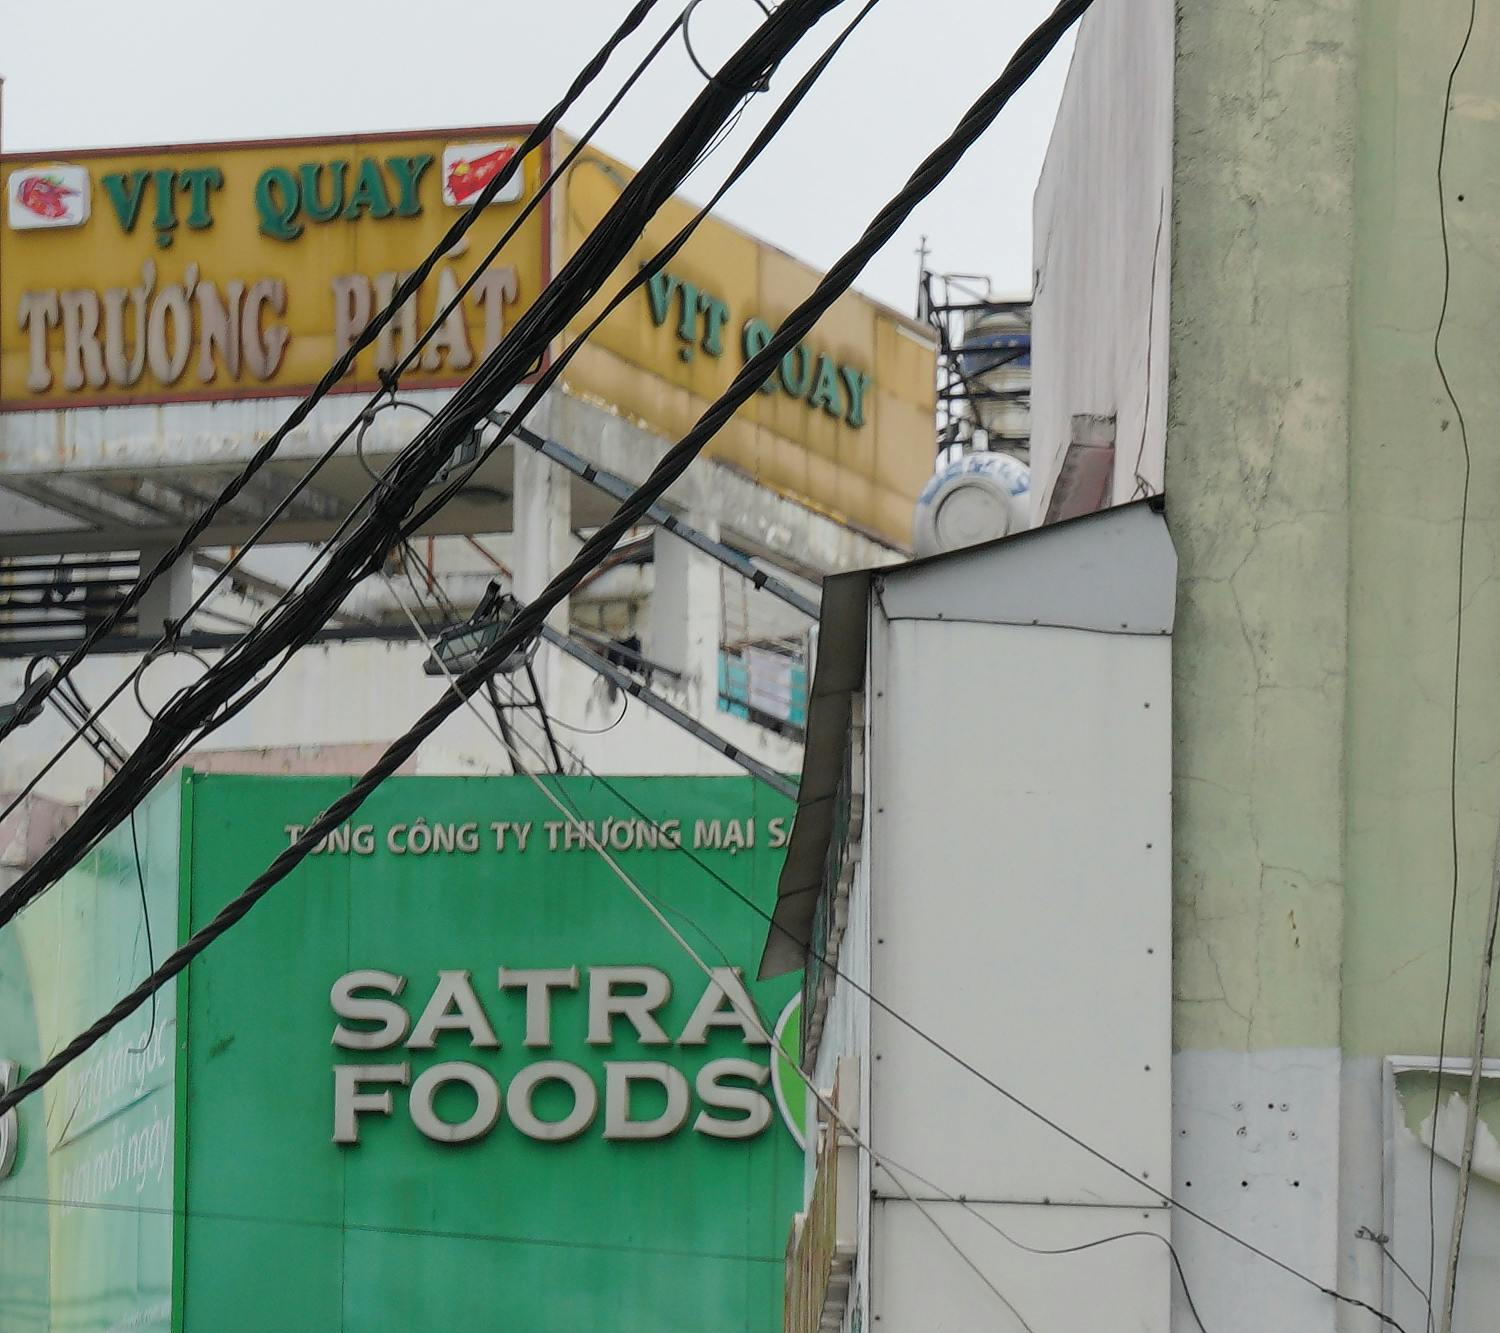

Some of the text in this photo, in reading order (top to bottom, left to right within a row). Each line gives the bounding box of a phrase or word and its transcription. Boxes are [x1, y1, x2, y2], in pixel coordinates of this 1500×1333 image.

[102, 154, 434, 248] VỊT QUAY
[642, 263, 728, 362] VỊT
[387, 817, 479, 854] CÔNG
[491, 821, 532, 851] TY
[545, 817, 681, 851] THƯƠNG
[694, 818, 755, 856] MẠI
[329, 966, 770, 1051] SATRA
[332, 1060, 772, 1145] FOODS
